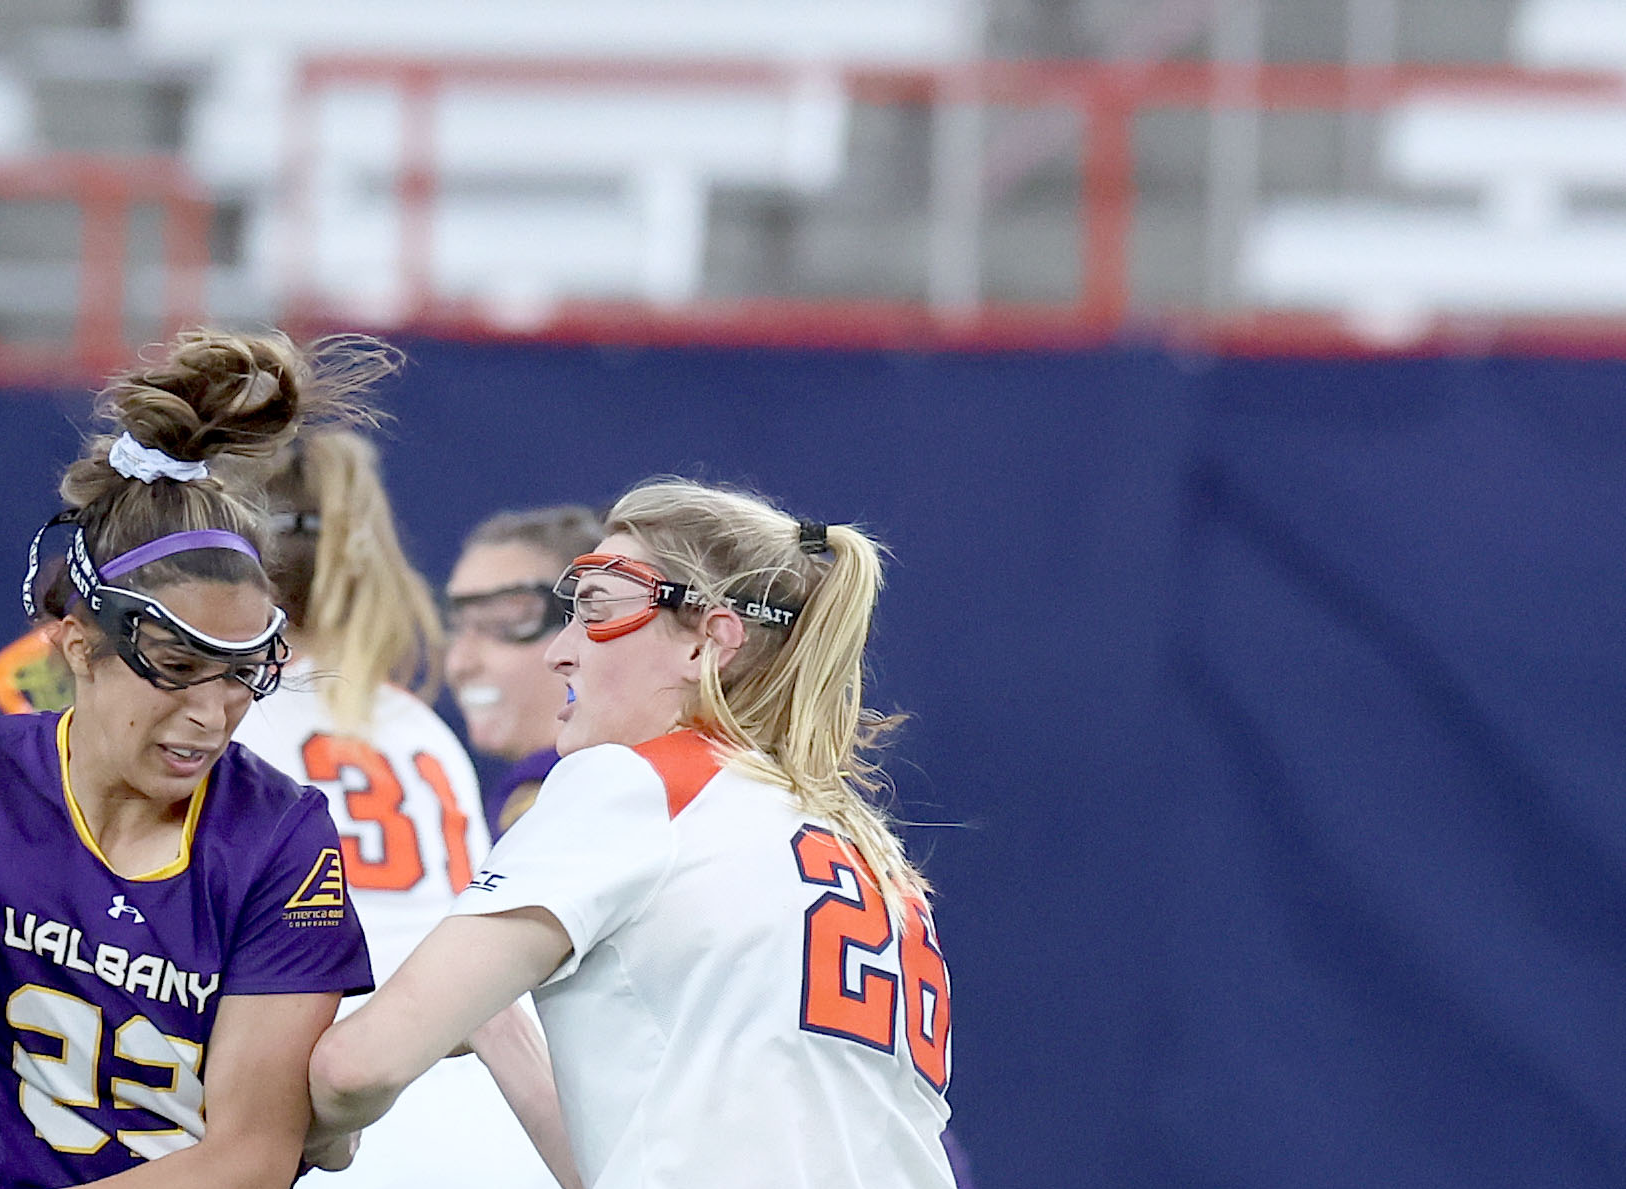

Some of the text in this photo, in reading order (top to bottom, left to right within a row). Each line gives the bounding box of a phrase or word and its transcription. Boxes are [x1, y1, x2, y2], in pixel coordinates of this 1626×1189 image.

[746, 602, 793, 625] GAIT
[301, 732, 472, 896] 31
[4, 906, 220, 1013] UALBANY
[790, 823, 952, 1095] 26
[6, 983, 207, 1162] 23
